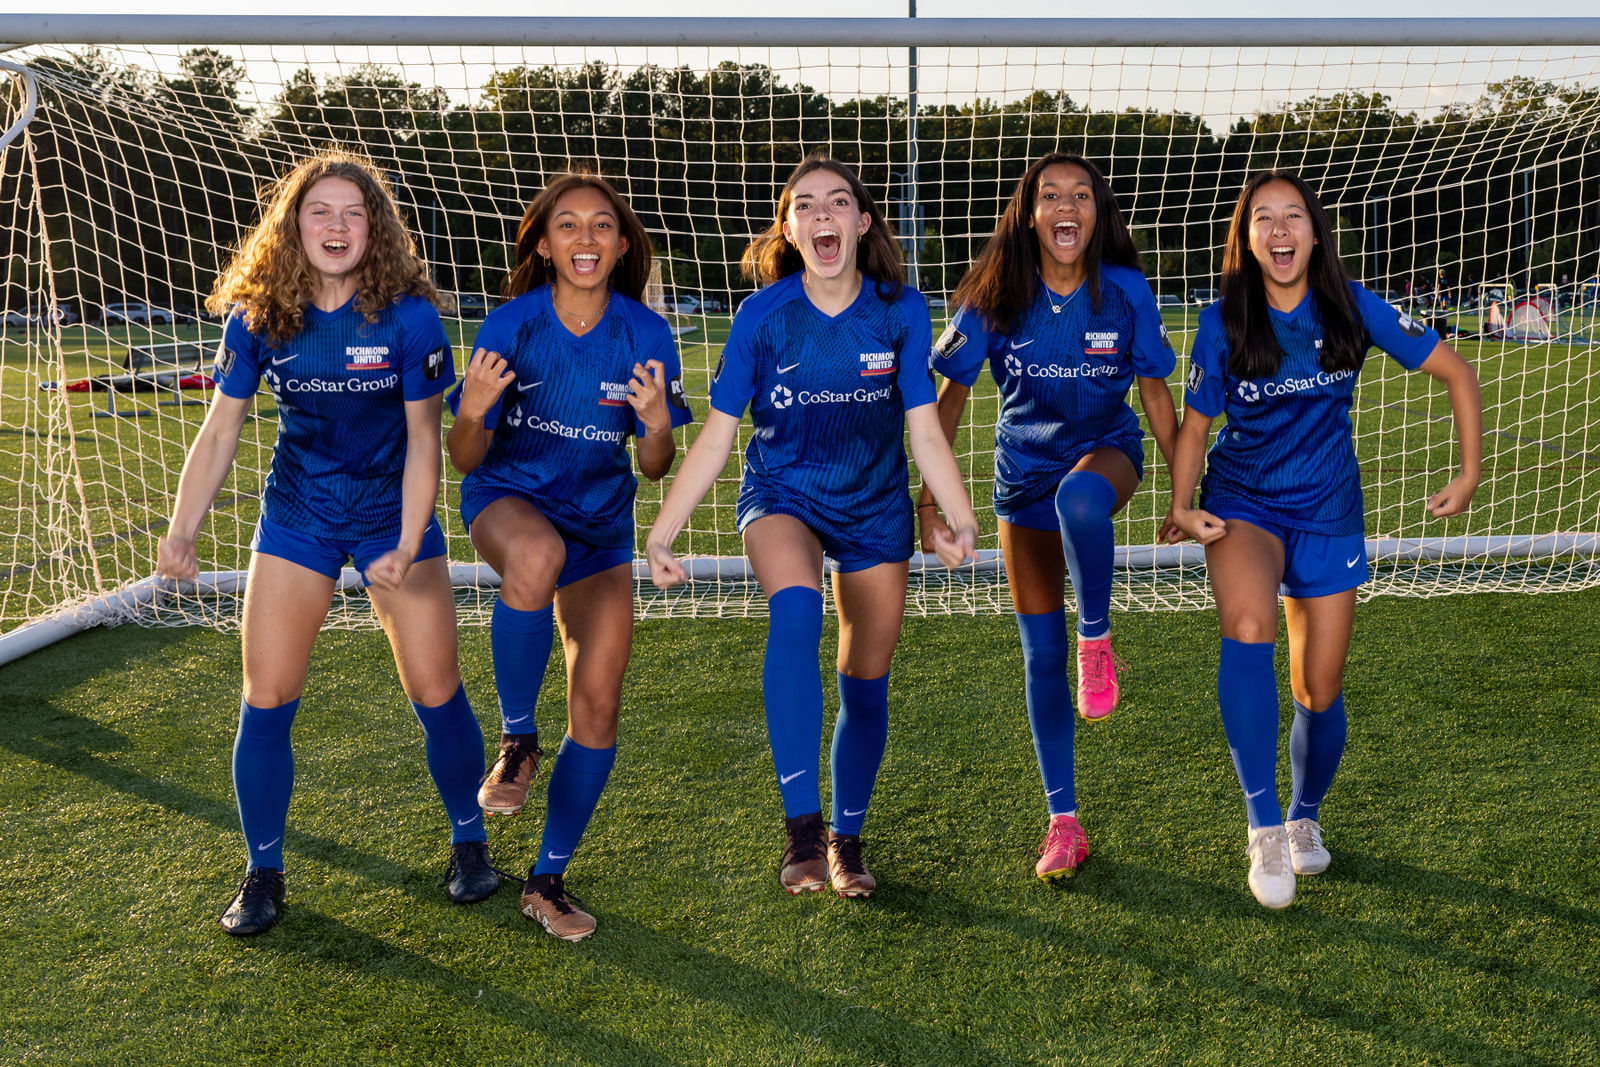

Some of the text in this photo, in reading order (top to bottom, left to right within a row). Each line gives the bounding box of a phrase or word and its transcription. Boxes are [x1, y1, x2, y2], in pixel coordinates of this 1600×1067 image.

[1091, 340, 1115, 349] UNITED
[346, 346, 389, 356] RICHMOND
[860, 351, 895, 362] RICHMON
[353, 355, 383, 364] UNITED
[867, 360, 893, 370] UNITED
[1027, 363, 1118, 378] CoStar Group
[286, 373, 398, 392] CoStar Group
[600, 381, 631, 393] RICHMO
[1263, 377, 1315, 397] CoStar
[606, 391, 628, 401] UNITE
[798, 385, 893, 405] CoStar Group
[527, 415, 625, 445] CoStar Group
